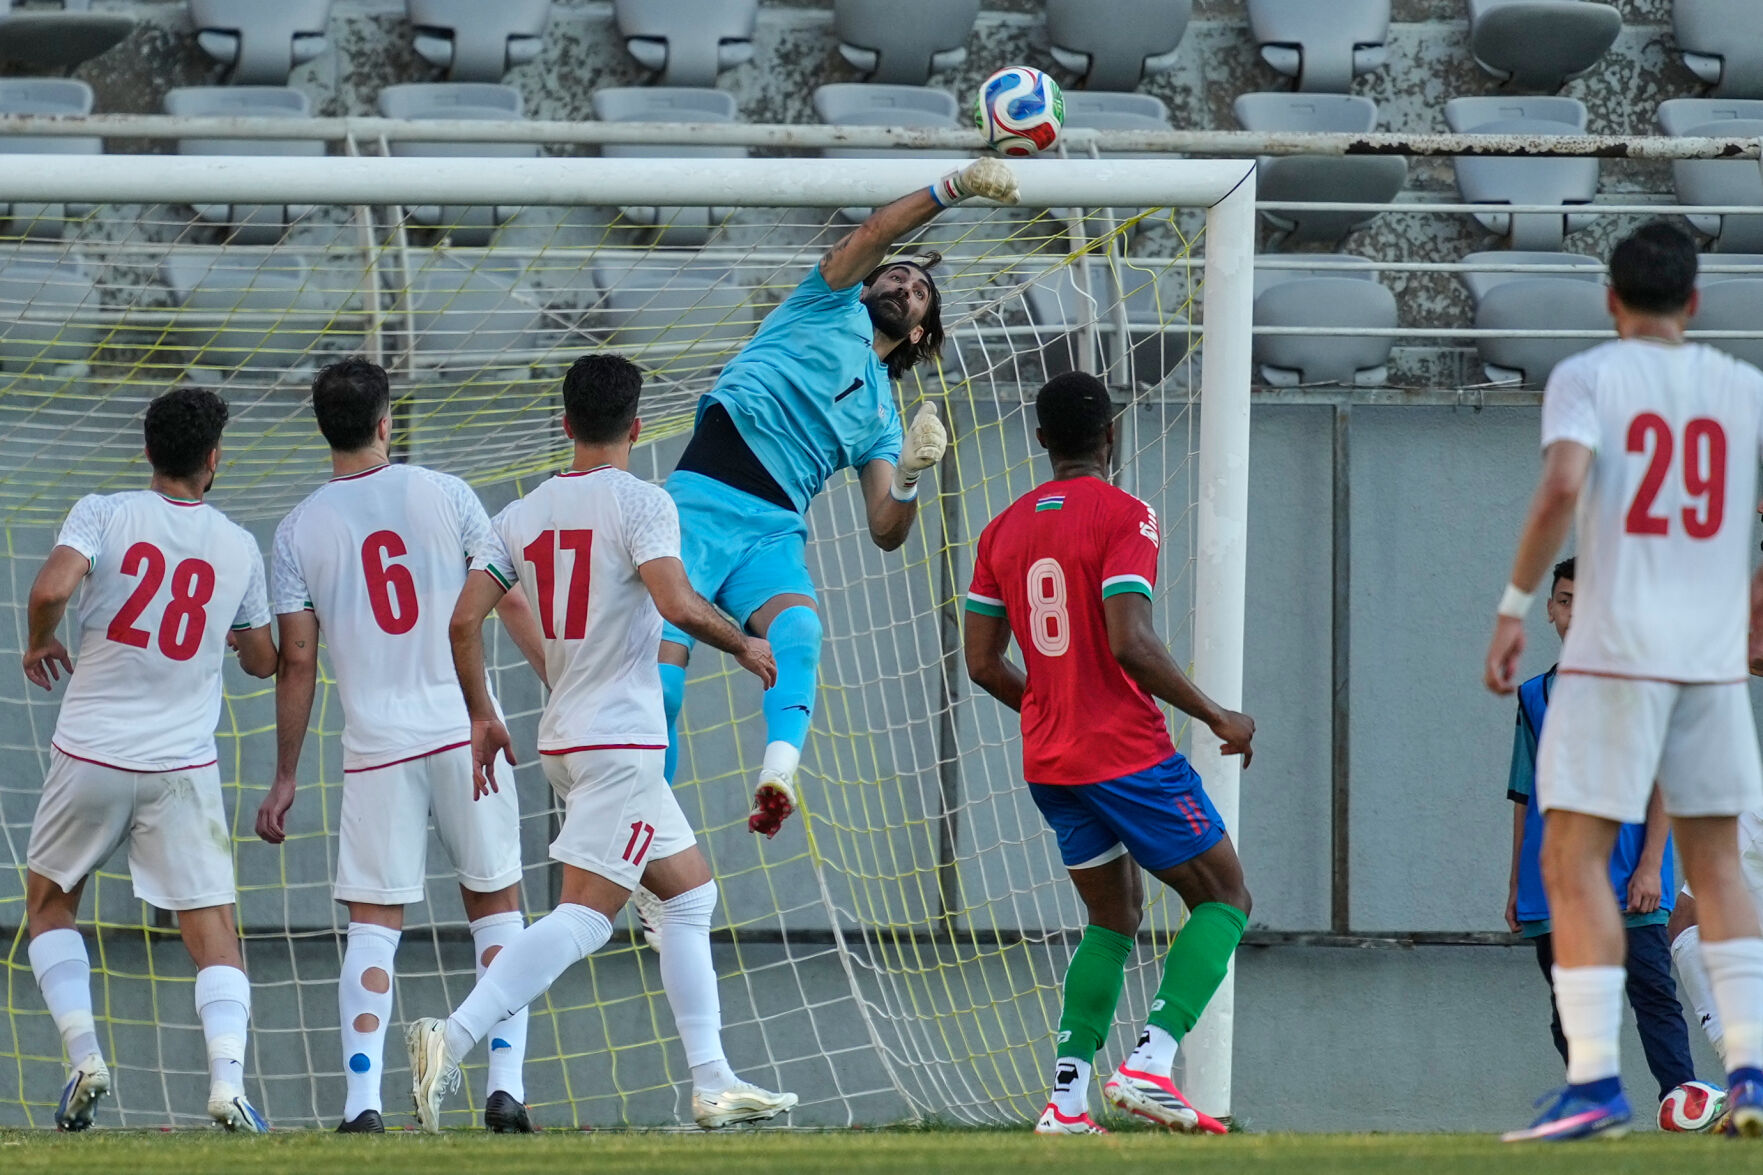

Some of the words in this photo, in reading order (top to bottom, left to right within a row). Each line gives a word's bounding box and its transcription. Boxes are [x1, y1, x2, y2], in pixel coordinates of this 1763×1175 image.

[834, 377, 864, 403] 1
[1625, 412, 1727, 540] 29
[107, 541, 216, 661] 28
[361, 530, 419, 635] 6
[523, 528, 594, 640] 17
[1026, 557, 1070, 657] 8
[623, 821, 655, 865] 17
